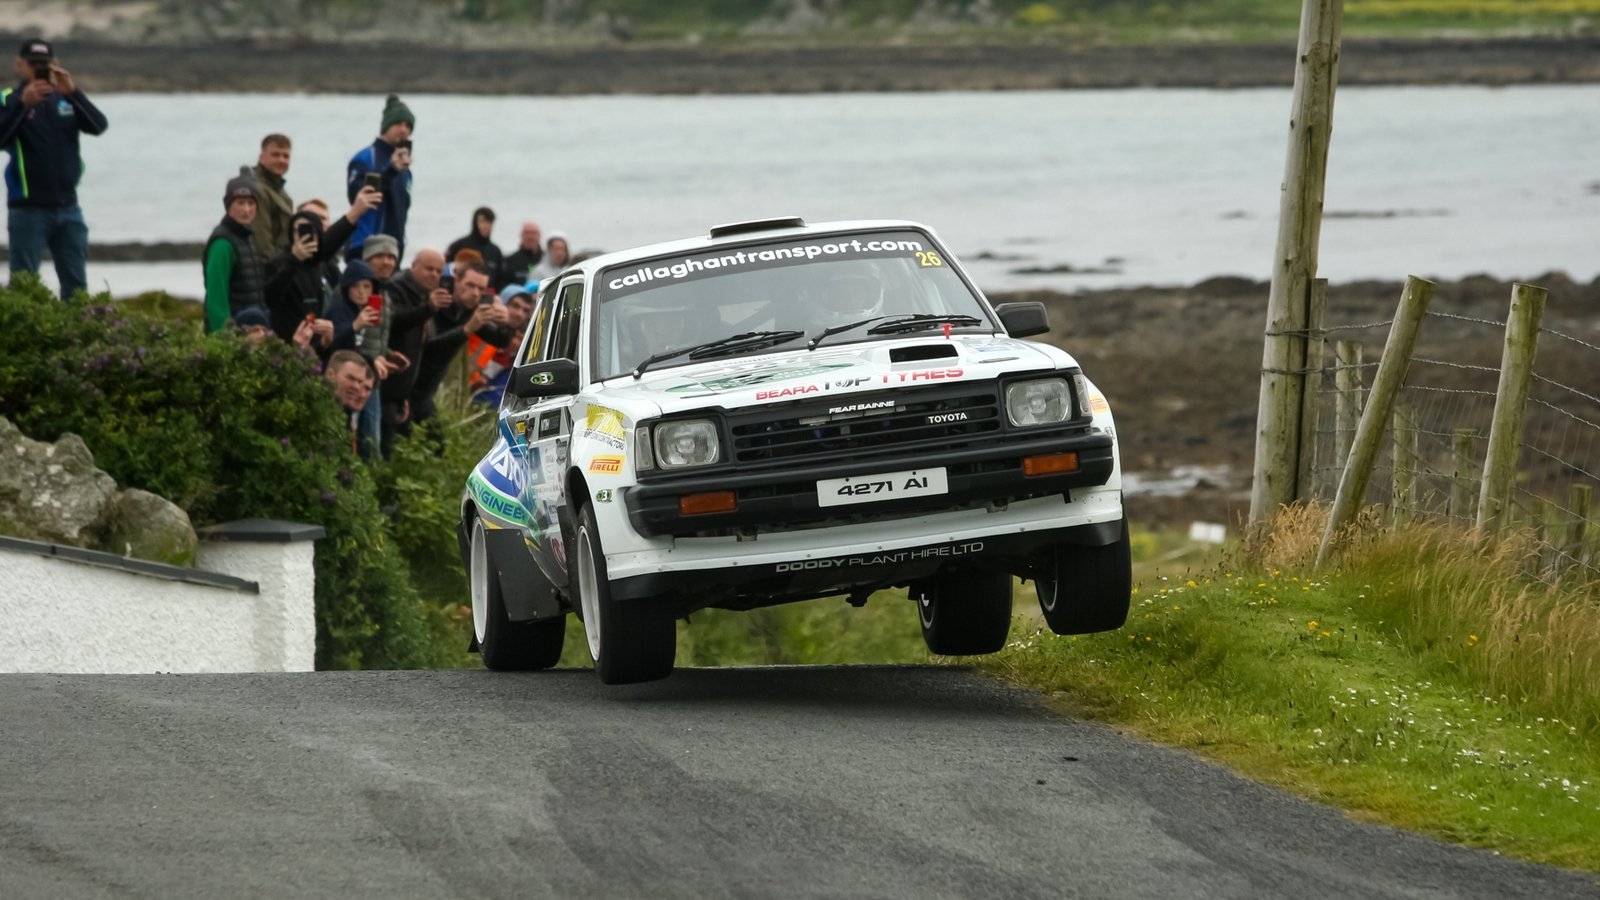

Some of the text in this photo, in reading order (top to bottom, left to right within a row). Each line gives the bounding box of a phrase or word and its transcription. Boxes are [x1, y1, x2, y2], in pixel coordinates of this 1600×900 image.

[609, 239, 922, 291] callaghantransport.com
[915, 251, 942, 267] 26
[755, 384, 819, 401] BEARA
[881, 368, 964, 383] TYRES
[829, 400, 895, 414] FEAR BAINNE
[928, 412, 968, 424] TOYOTA
[590, 458, 621, 472] PIRELLI
[837, 477, 928, 496] 4271 AI
[775, 542, 984, 573] DOODY PLANT HIRE LTD
